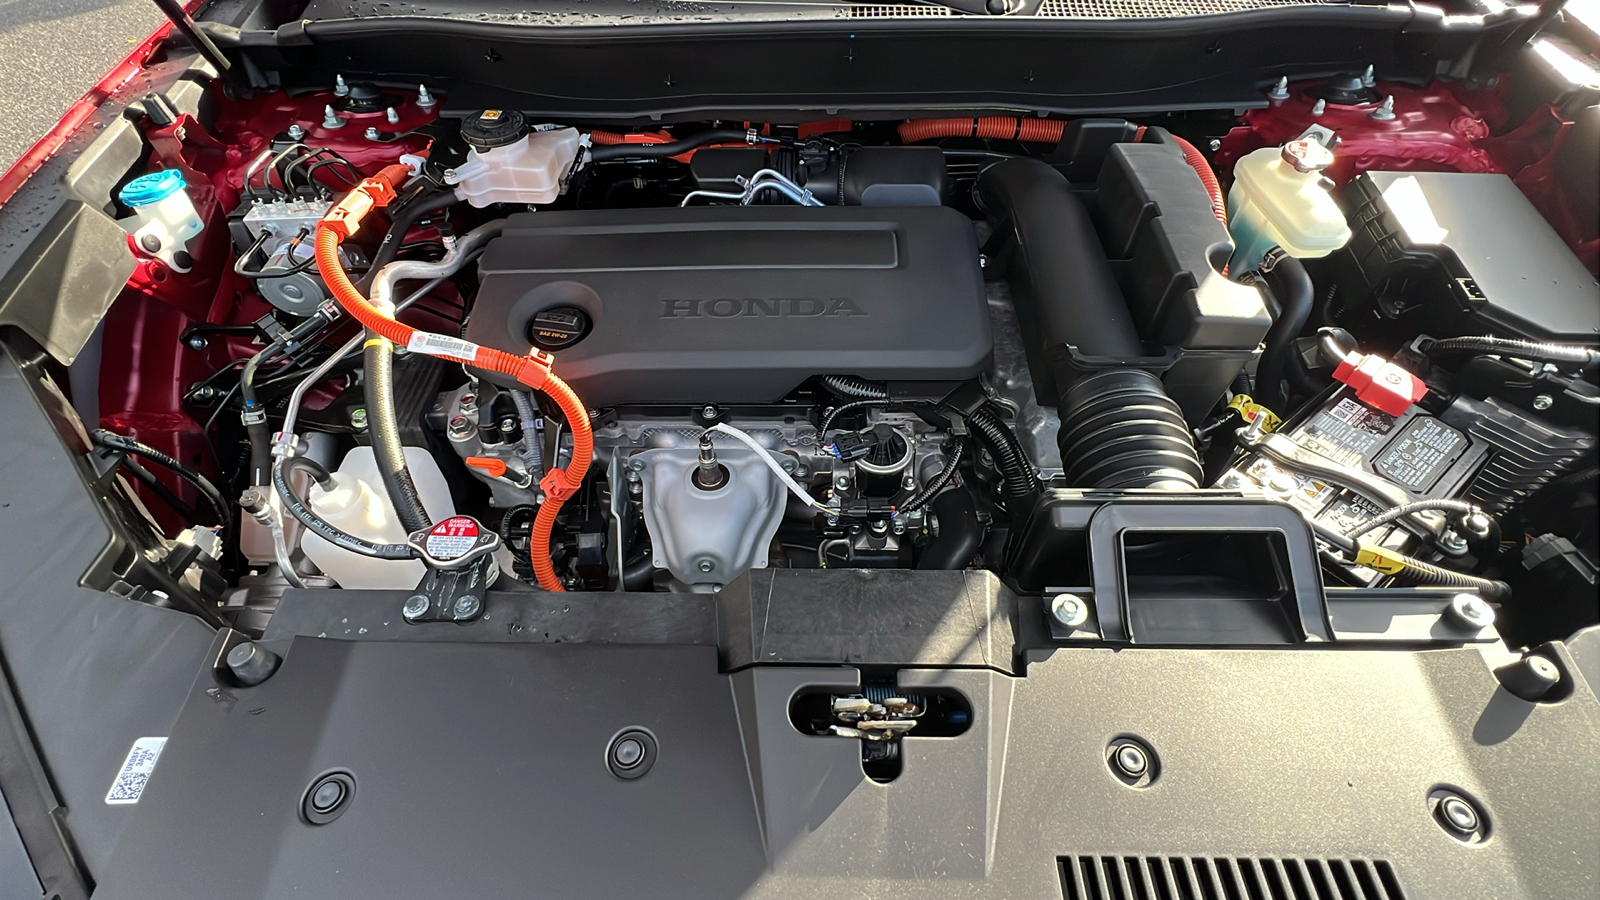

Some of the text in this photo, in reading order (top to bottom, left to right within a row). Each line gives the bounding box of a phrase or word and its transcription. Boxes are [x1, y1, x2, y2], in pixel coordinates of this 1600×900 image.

[658, 297, 870, 319] HONDA
[1343, 401, 1358, 412] 5A
[124, 746, 143, 771] UK08FY
[146, 752, 155, 761] A2
